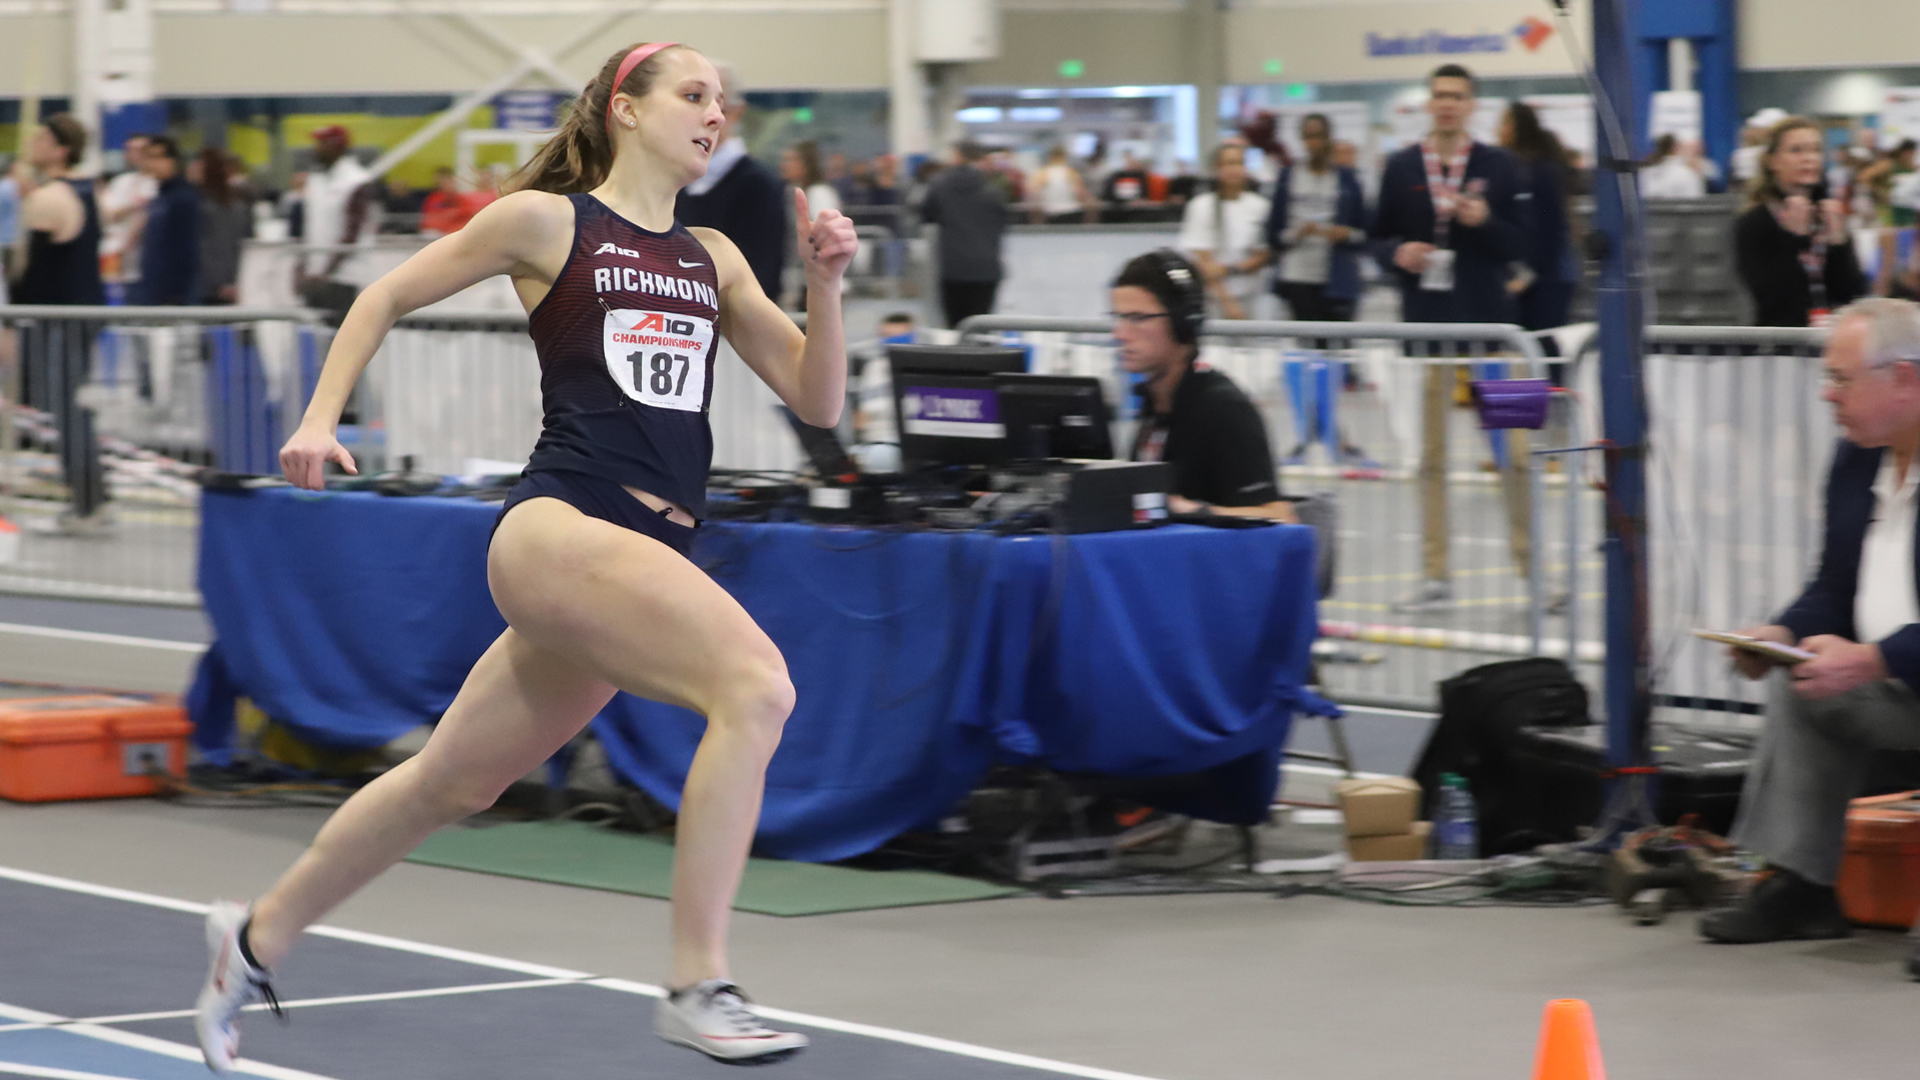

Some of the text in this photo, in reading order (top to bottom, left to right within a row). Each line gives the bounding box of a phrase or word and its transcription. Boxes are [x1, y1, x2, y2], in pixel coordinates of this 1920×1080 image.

[594, 243, 640, 258] A10
[594, 267, 718, 311] RICHMOND
[630, 312, 695, 336] A10
[612, 333, 703, 351] CHAMPIONSHIPS
[626, 351, 690, 397] 187
